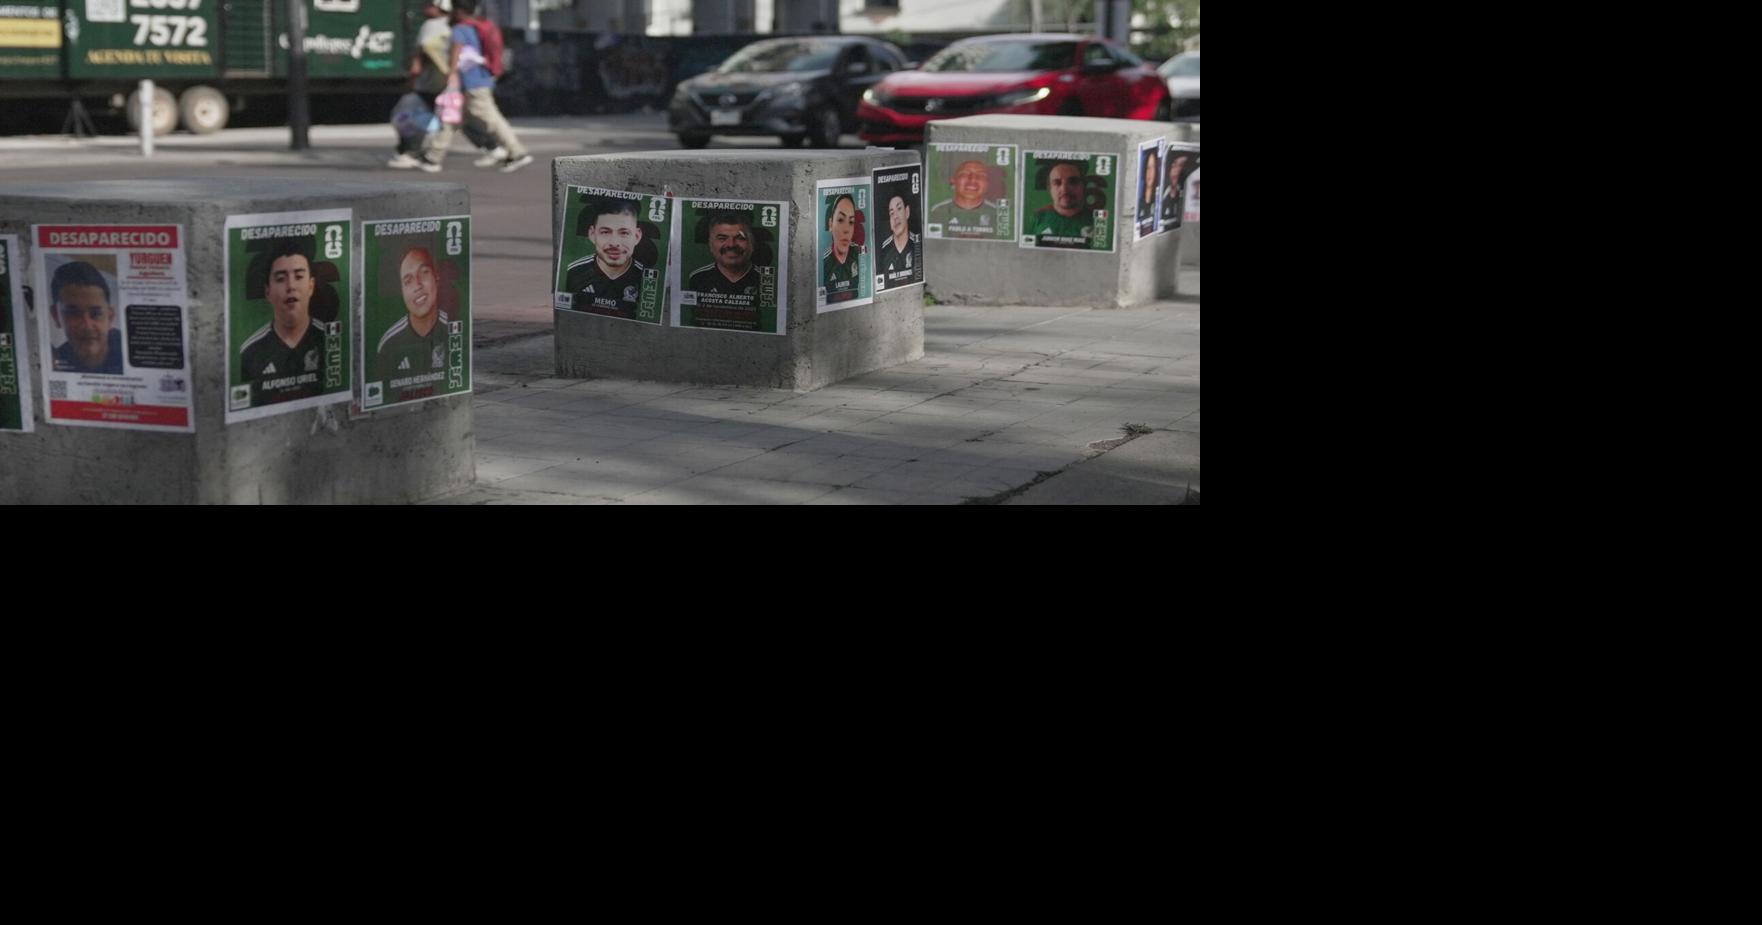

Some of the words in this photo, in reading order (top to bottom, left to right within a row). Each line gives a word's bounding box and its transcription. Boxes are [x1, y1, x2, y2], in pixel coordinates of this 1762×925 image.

[130, 14, 208, 46] 7572
[692, 201, 754, 211] DESAPARECIDO
[241, 224, 317, 240] DESAPARECIDO
[375, 221, 441, 237] DESAPARECIDO
[50, 232, 170, 246] DESAPARECIDO
[594, 297, 617, 307] MEMO
[262, 376, 296, 390] ALFONSO
